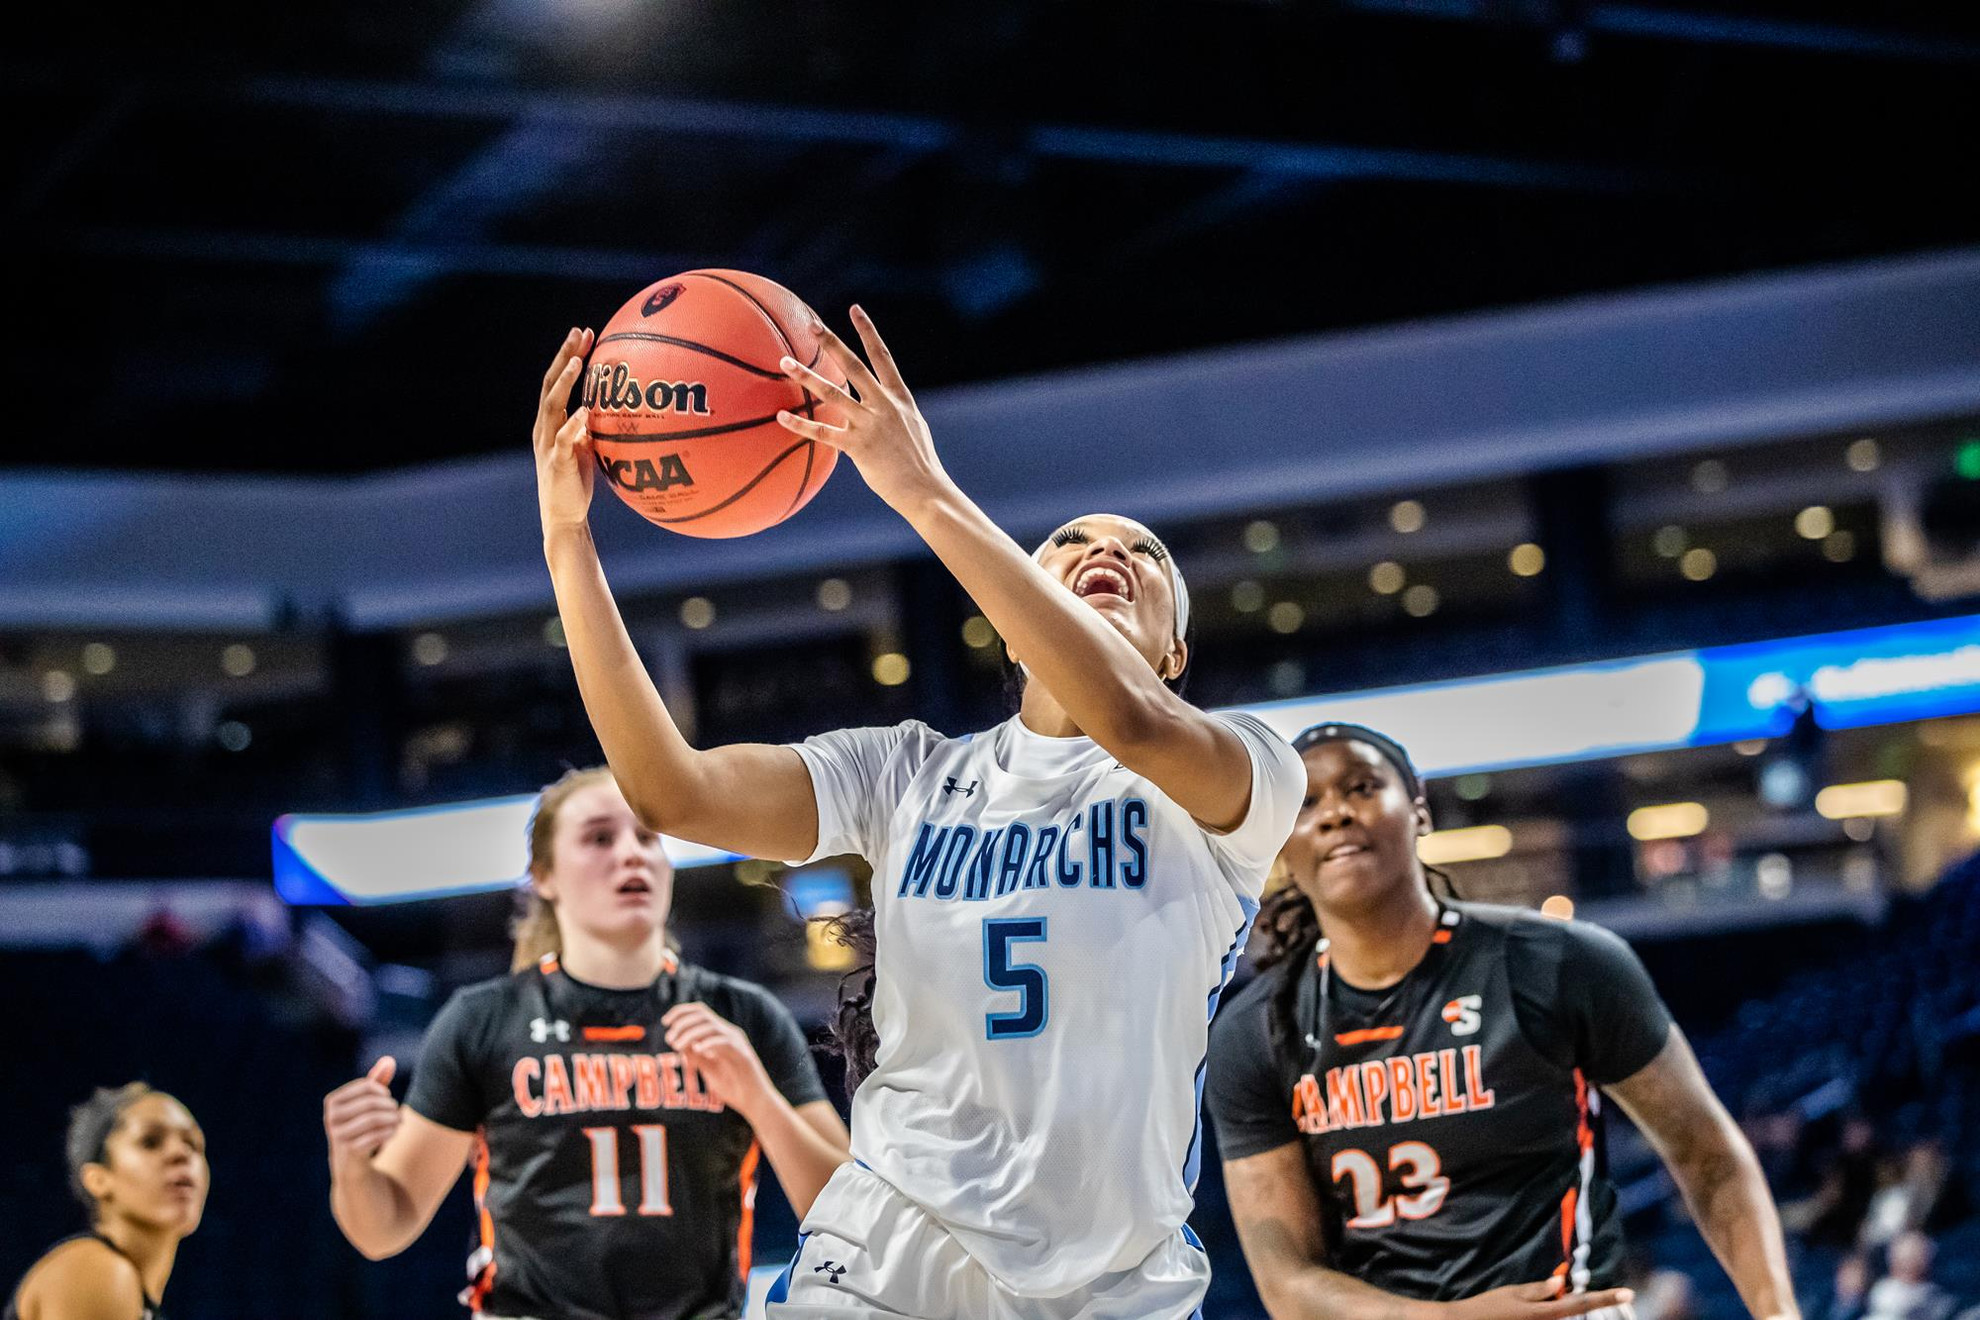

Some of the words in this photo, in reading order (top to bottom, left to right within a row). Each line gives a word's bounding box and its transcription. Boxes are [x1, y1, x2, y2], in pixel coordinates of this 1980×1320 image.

[582, 361, 710, 416] Wilson
[897, 797, 1149, 901] MONARCHS
[982, 916, 1049, 1040] 5
[582, 1124, 674, 1217] 11
[1331, 1140, 1450, 1228] 23
